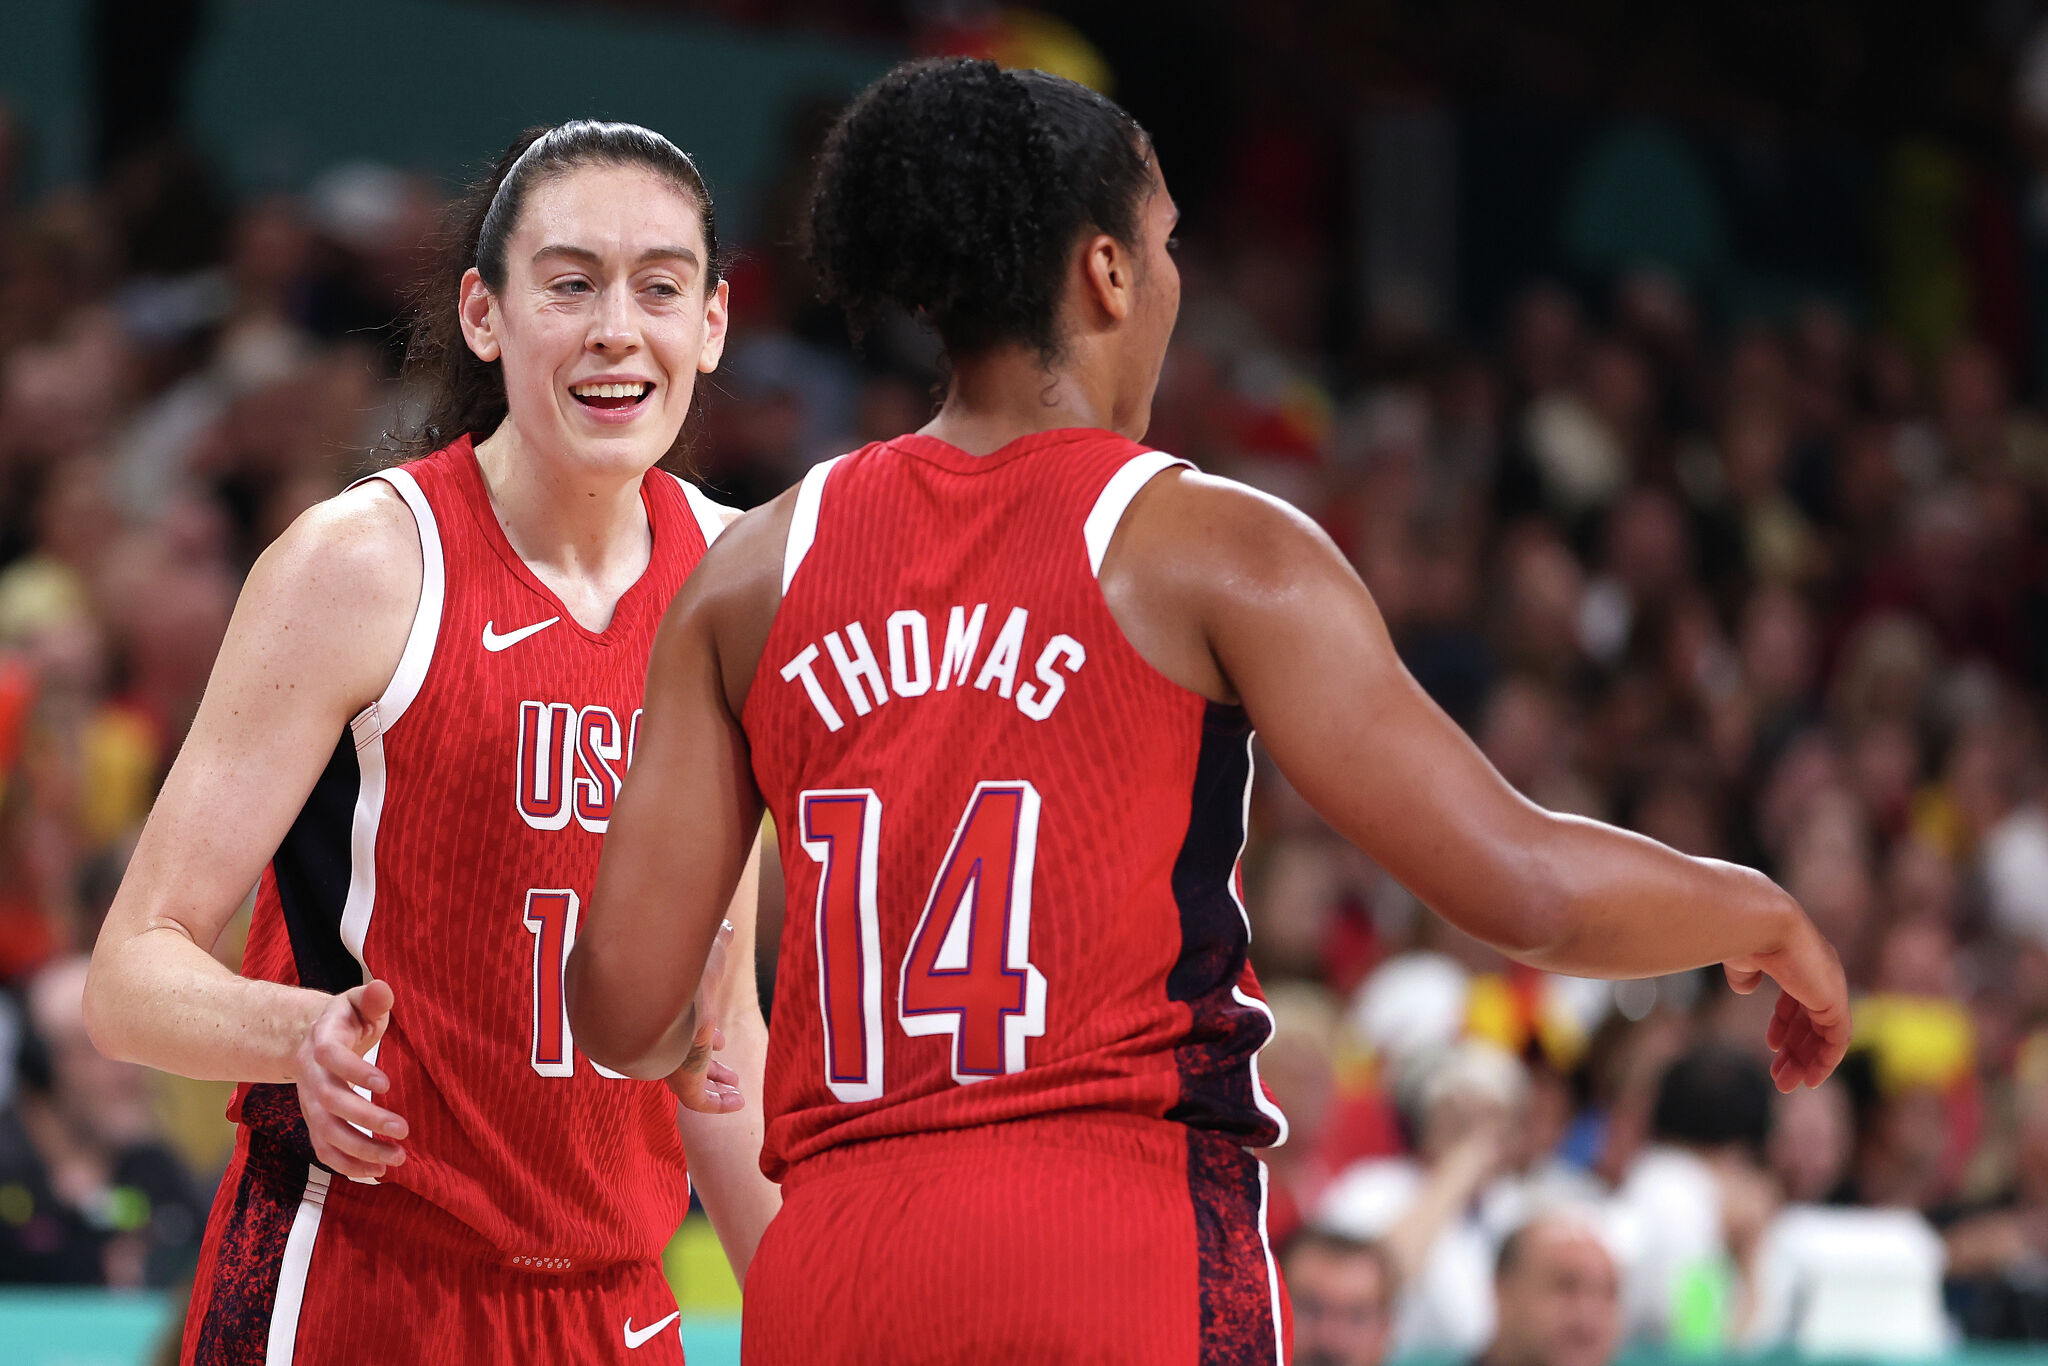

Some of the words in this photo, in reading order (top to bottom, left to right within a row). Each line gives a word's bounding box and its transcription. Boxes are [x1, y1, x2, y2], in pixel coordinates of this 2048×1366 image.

[780, 603, 1086, 732] THOMAS
[516, 700, 643, 833] US
[522, 888, 632, 1078] 1
[799, 780, 1047, 1102] 14
